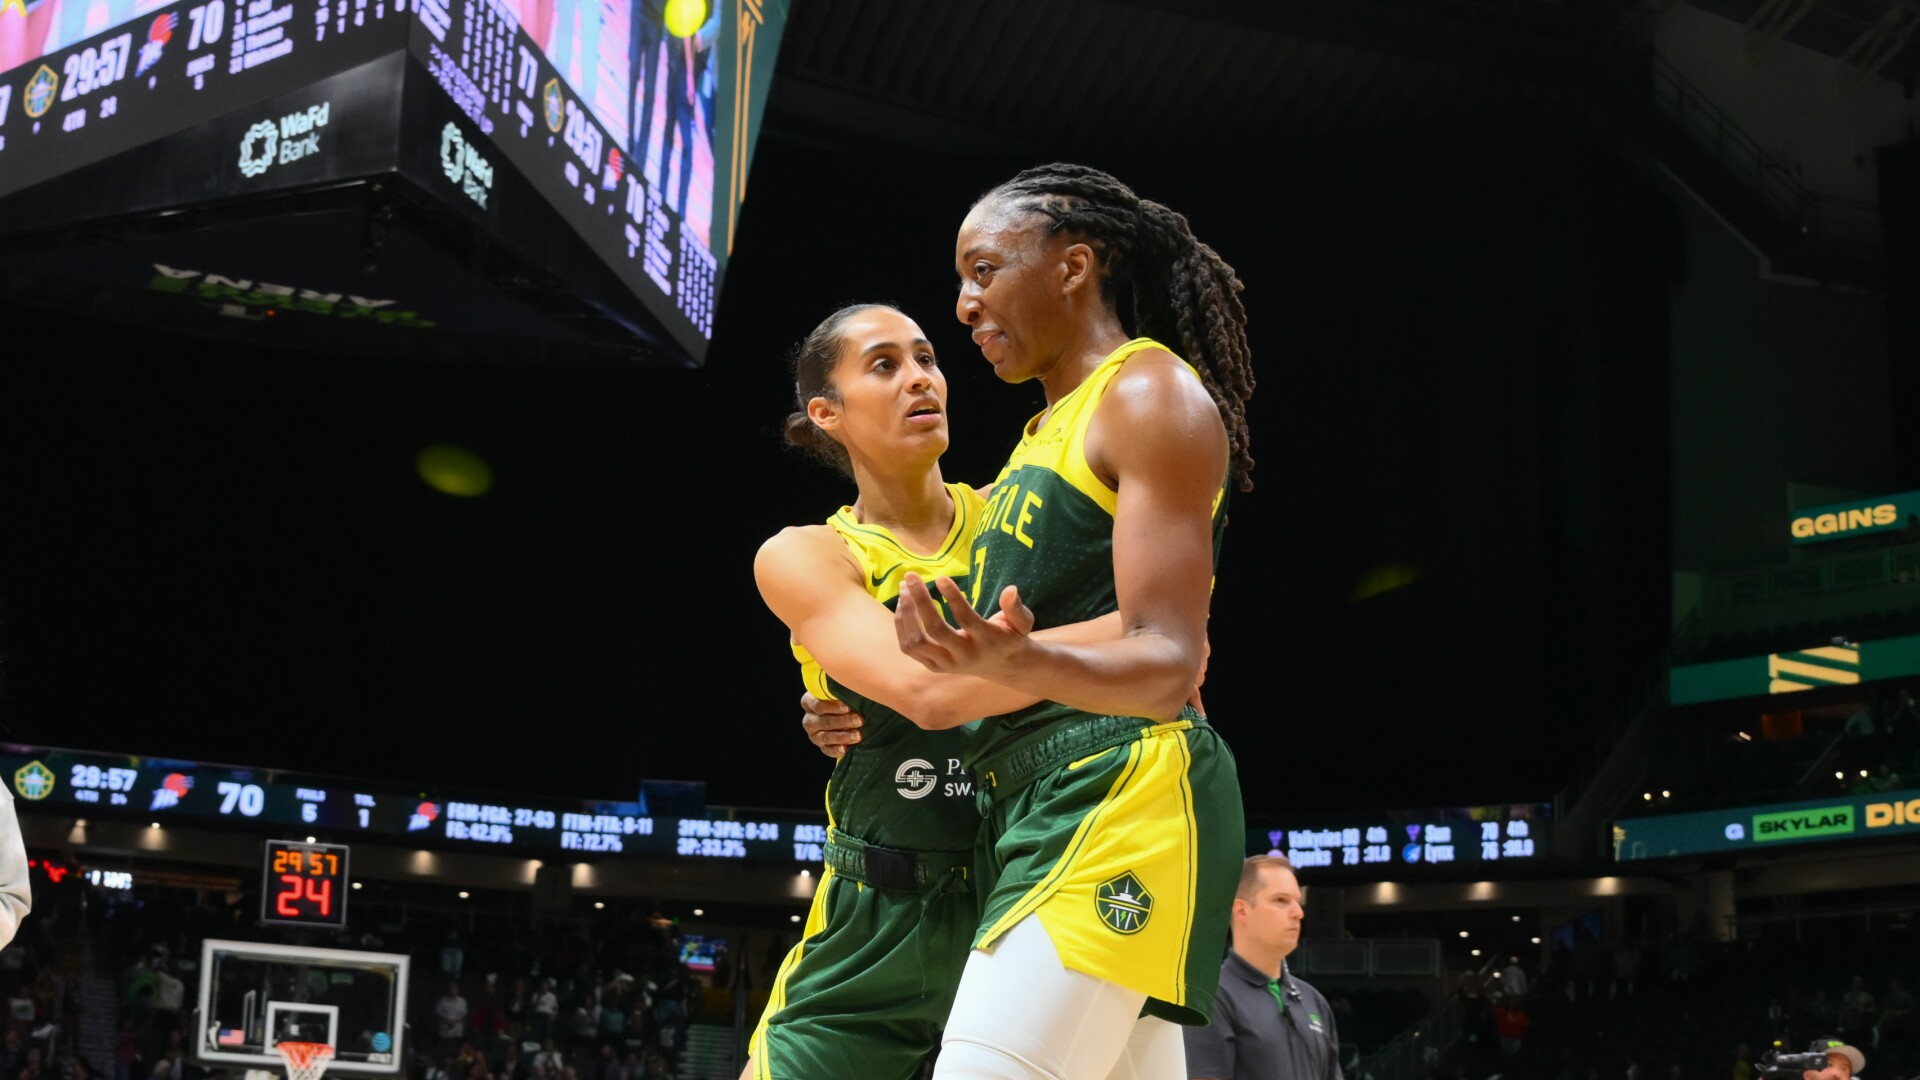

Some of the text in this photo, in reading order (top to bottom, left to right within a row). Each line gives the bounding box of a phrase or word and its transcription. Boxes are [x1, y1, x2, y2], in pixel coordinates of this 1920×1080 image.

[60, 32, 133, 102] 29:57
[280, 101, 330, 139] WaFd
[279, 131, 321, 165] Bank
[1791, 504, 1897, 538] GGINS
[70, 764, 138, 792] 29:57
[217, 781, 265, 817] 70
[301, 802, 318, 824] 5
[357, 808, 370, 829] 1
[1424, 823, 1452, 844] Sun
[1758, 813, 1849, 835] SKYLAR
[1424, 842, 1455, 865] Lynx
[276, 873, 332, 918] 24
